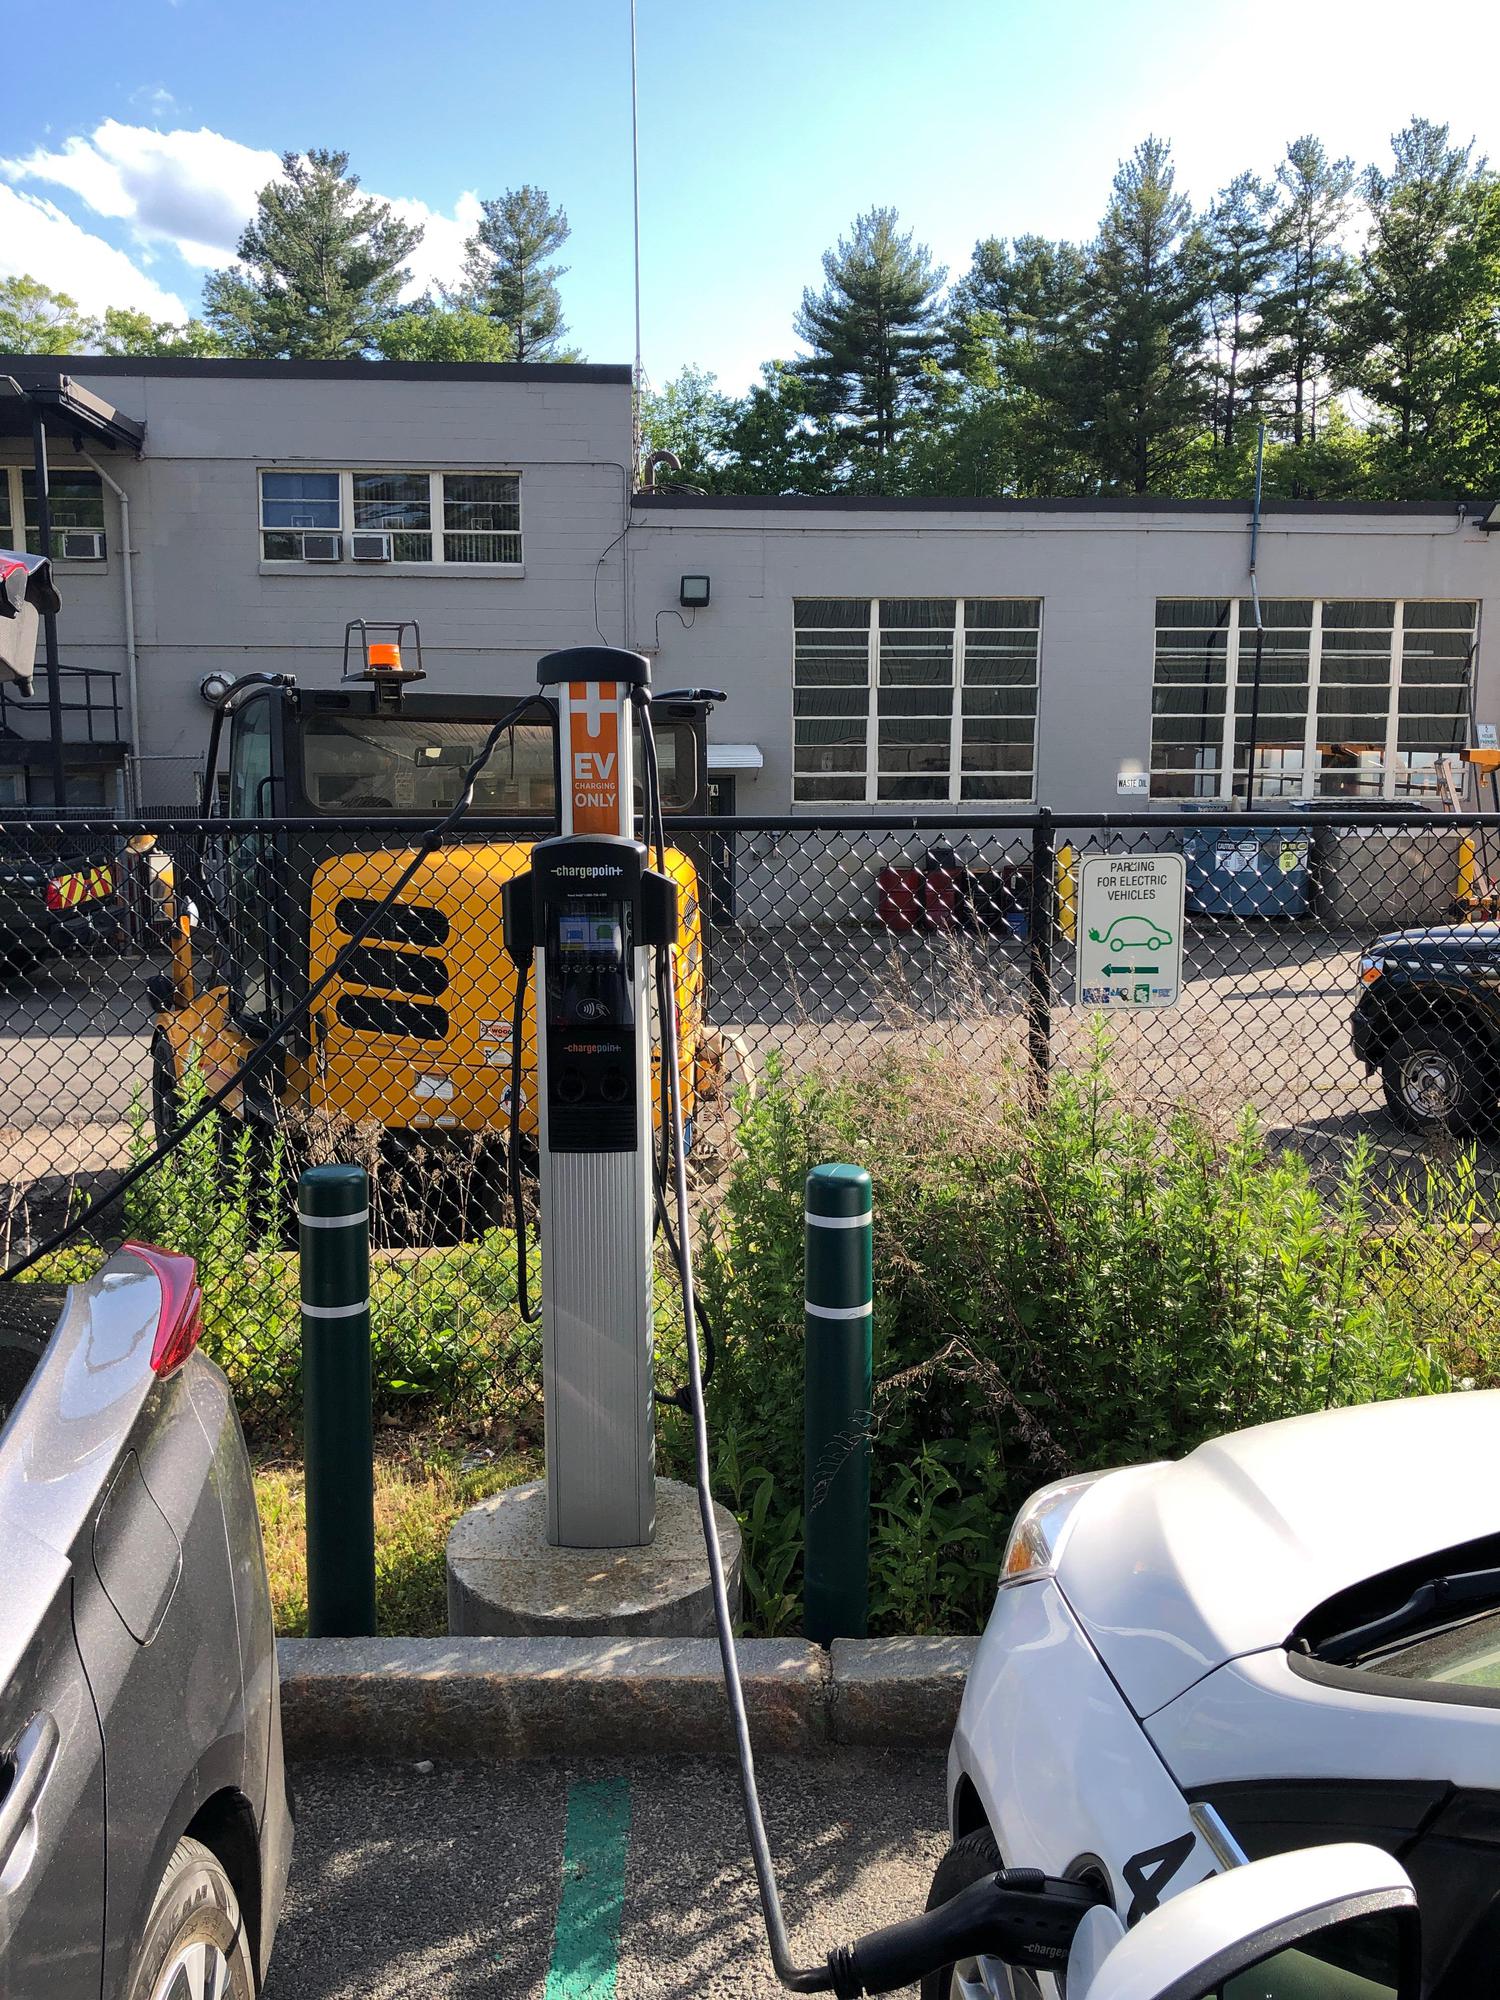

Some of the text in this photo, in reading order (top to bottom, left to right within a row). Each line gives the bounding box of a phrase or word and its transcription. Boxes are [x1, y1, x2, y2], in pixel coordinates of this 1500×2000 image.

[574, 752, 616, 780] EV
[574, 782, 616, 790] CHARGING
[1119, 779, 1148, 788] WASTE OIL
[575, 793, 616, 808] ONLY
[1110, 861, 1155, 873] PARKING
[1097, 874, 1167, 887] FOR ELECTRIC
[1107, 889, 1156, 901] VEHICLES
